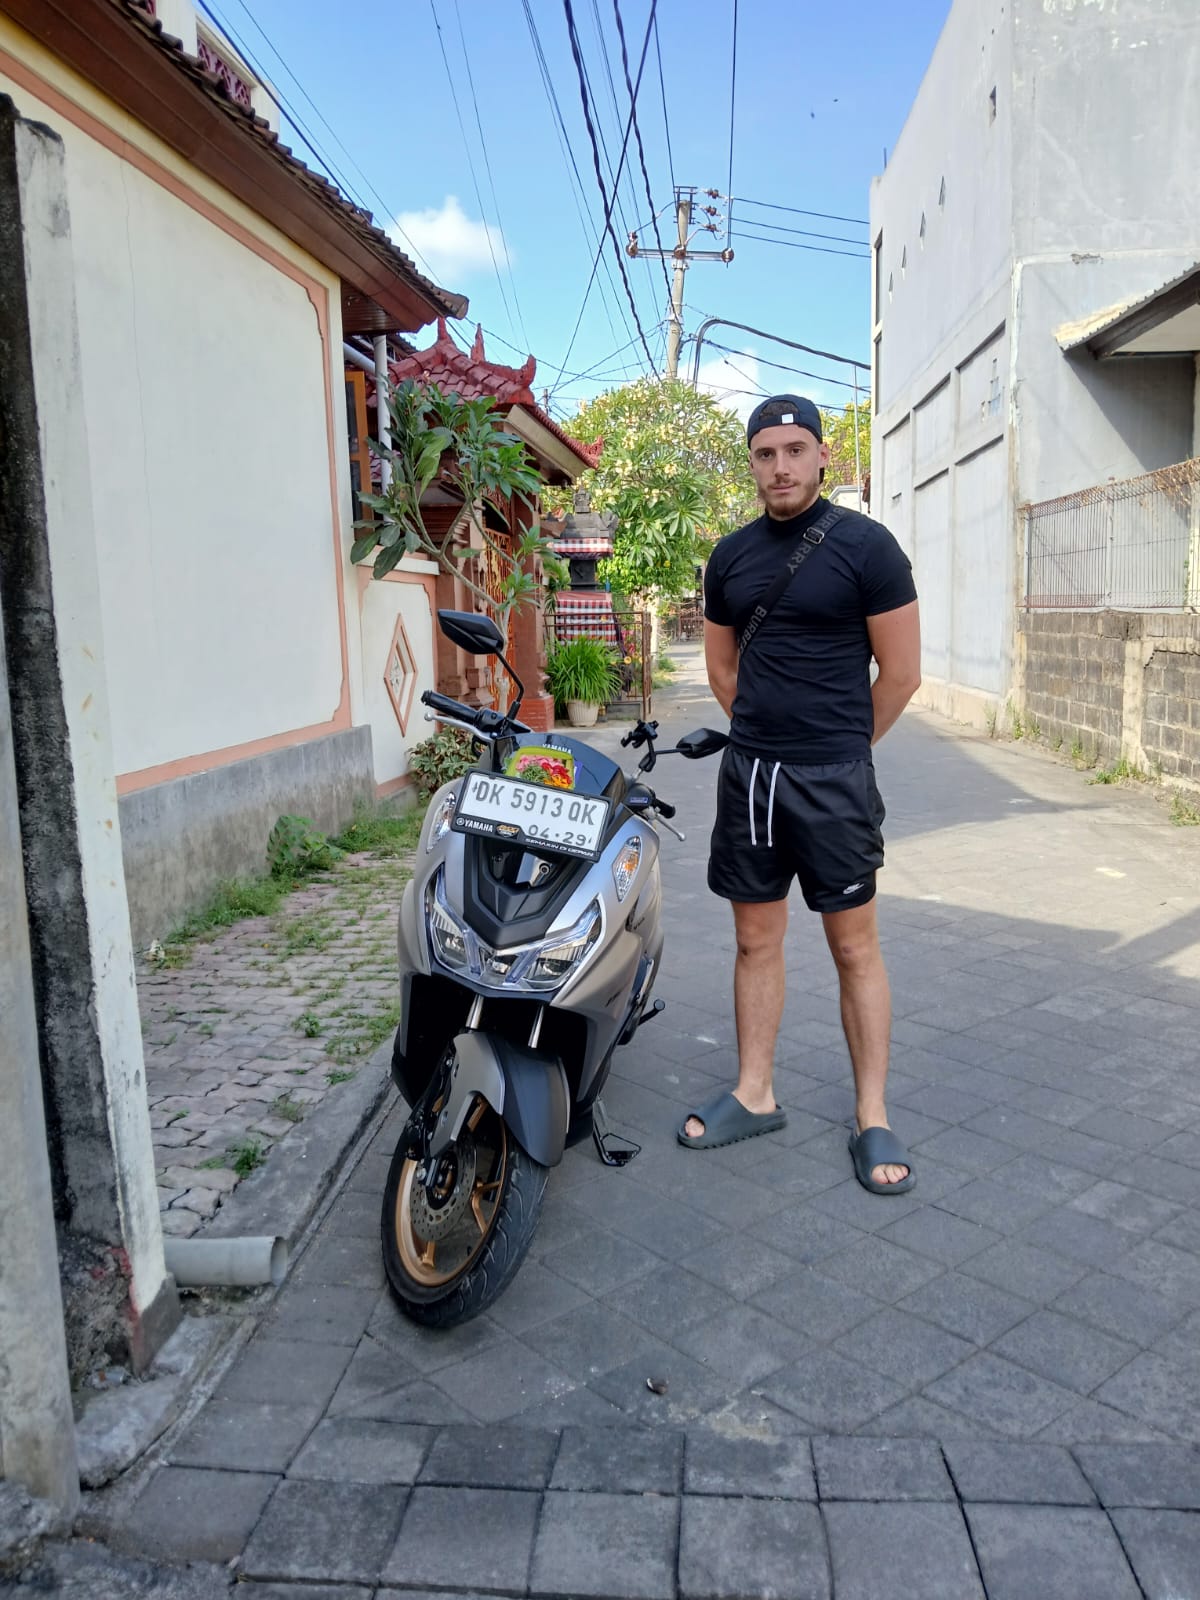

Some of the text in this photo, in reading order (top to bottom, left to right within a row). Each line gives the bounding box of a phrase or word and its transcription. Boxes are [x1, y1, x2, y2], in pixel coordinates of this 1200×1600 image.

[542, 743, 572, 754] YAMAHA
[475, 781, 505, 806] DK
[510, 788, 563, 818] 5913
[464, 819, 493, 833] YAMAHA
